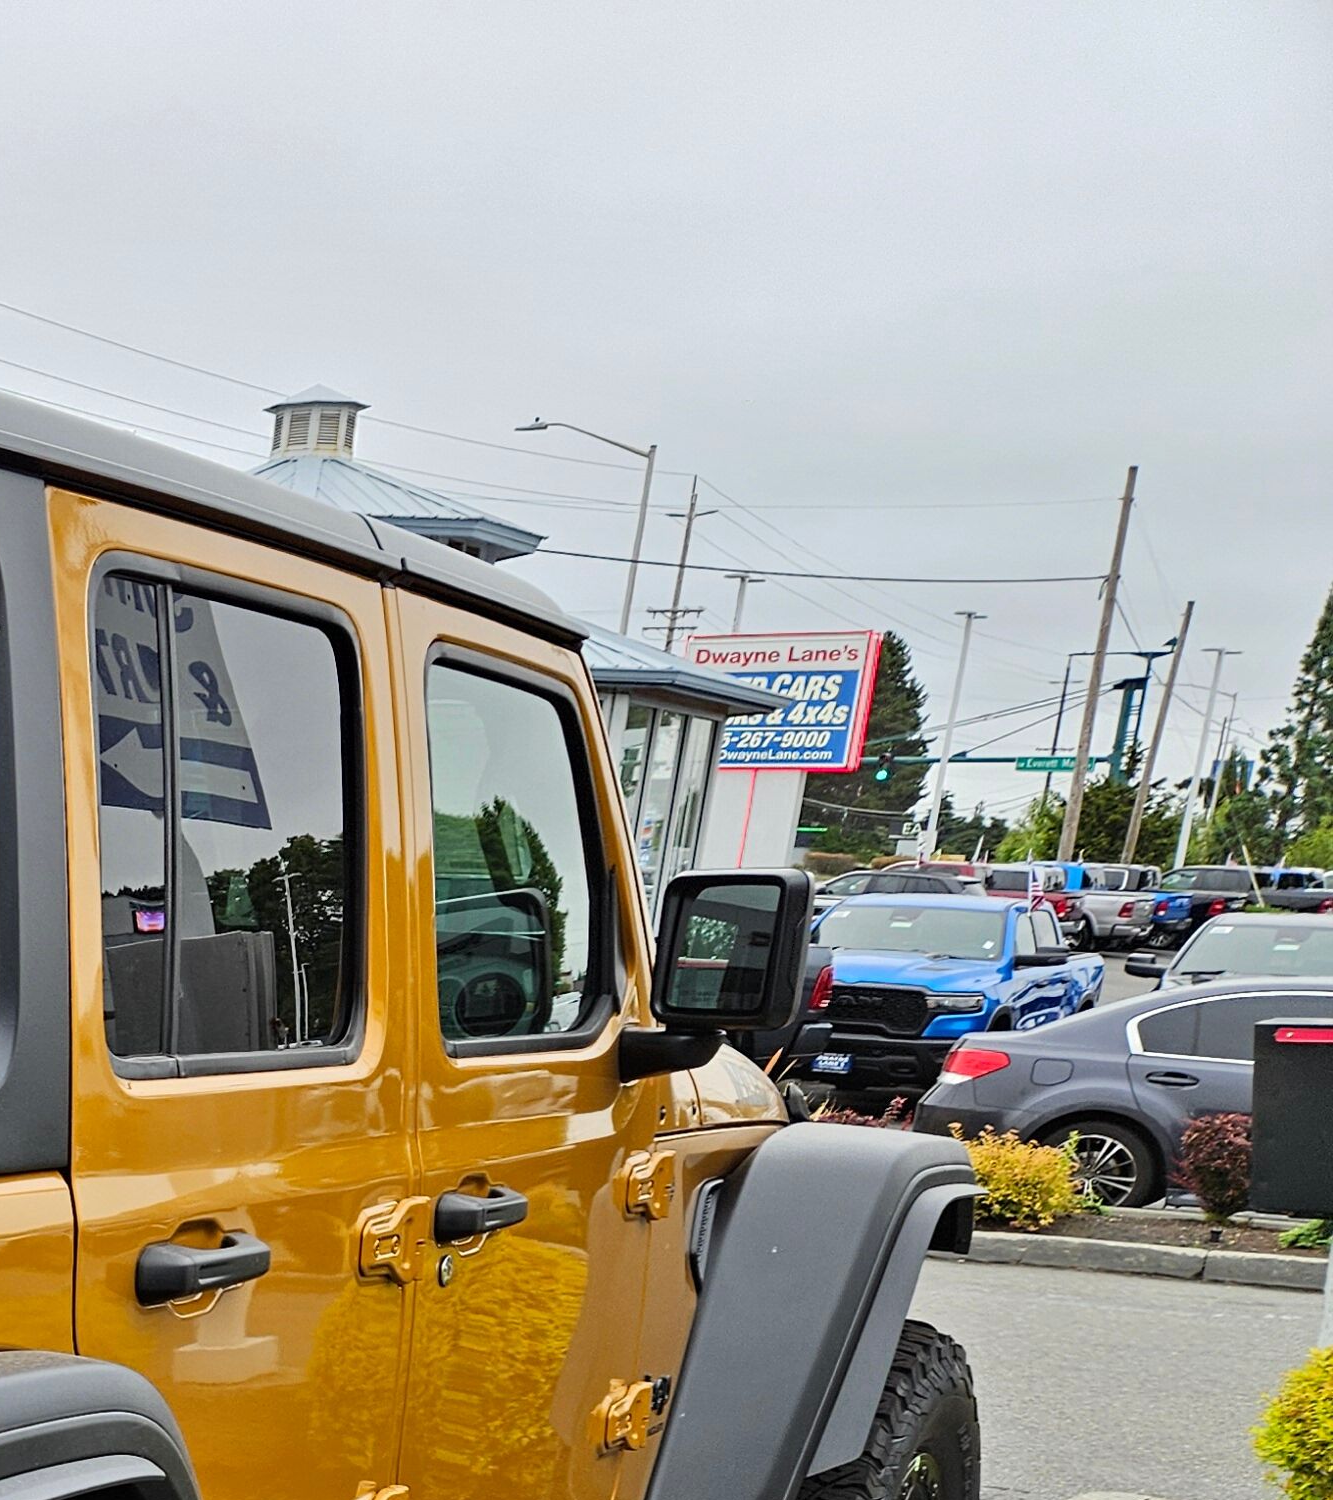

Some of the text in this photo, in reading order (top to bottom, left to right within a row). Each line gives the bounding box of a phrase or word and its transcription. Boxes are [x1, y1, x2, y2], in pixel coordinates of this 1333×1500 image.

[695, 645, 859, 667] Dwayne Lane's
[770, 673, 843, 701] CARS
[786, 701, 850, 725] 4x4s
